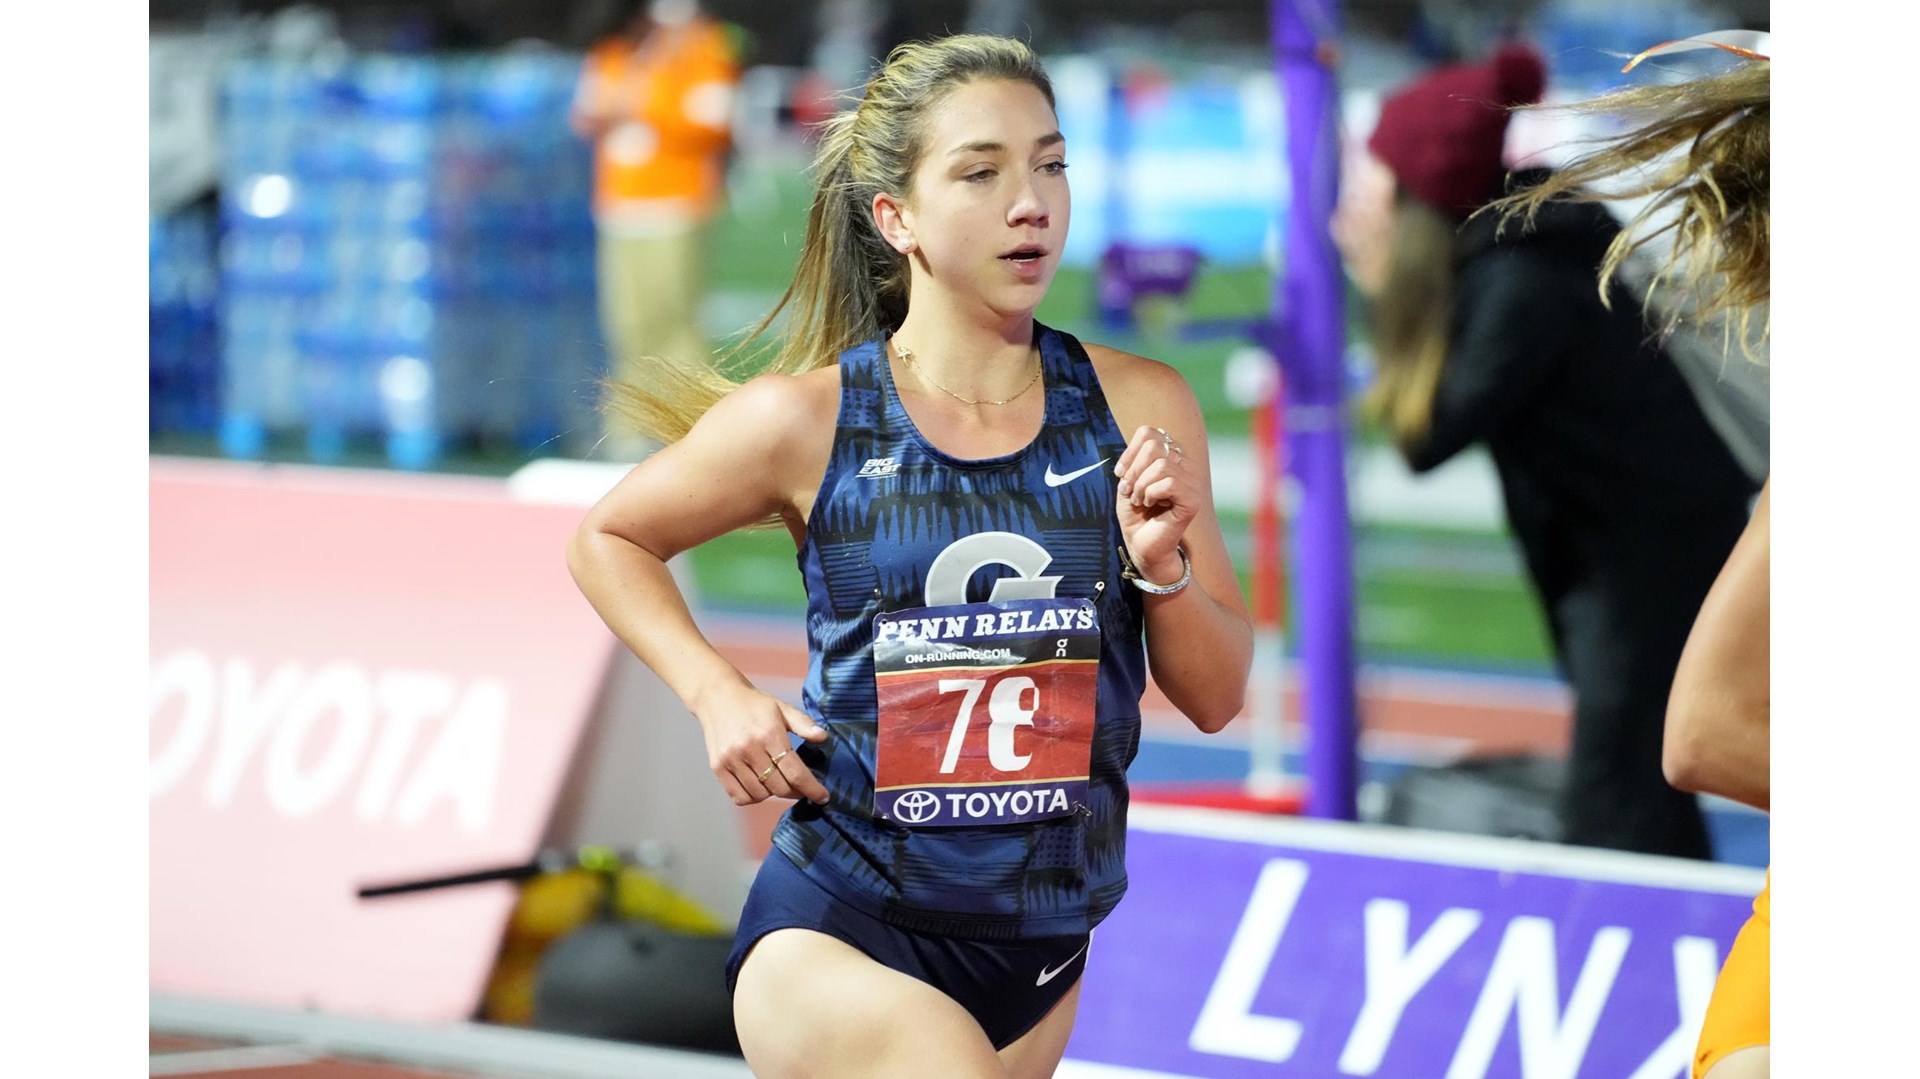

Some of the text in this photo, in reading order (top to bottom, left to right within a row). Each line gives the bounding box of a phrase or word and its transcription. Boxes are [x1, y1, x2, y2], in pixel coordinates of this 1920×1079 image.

[859, 464, 902, 474] EAST
[864, 457, 895, 466] BIG
[875, 608, 1093, 643] PENN RELAYS
[938, 676, 1040, 774] 78
[946, 788, 1069, 818] TOYOTA
